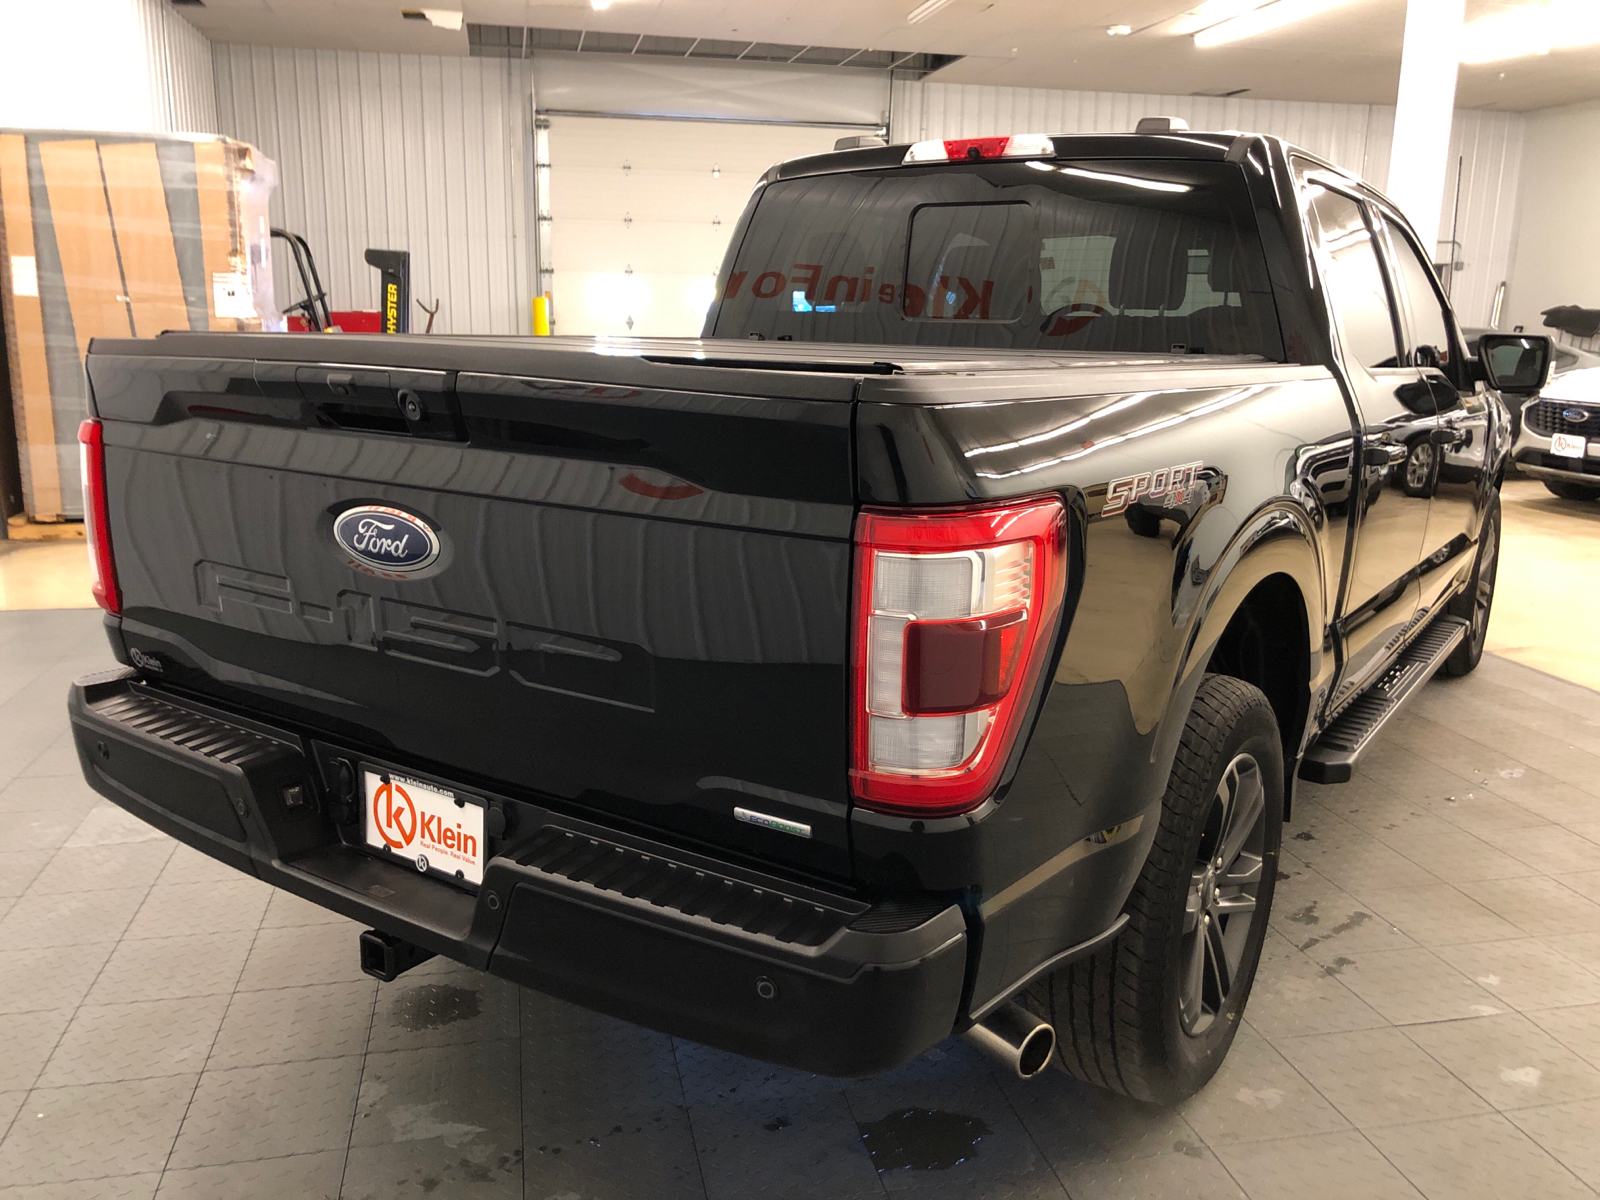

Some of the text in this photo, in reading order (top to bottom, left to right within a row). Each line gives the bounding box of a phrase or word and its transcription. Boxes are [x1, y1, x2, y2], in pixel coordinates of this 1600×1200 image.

[386, 283, 398, 334] HYSTER
[1101, 460, 1204, 518] SPORT
[353, 518, 409, 558] Ford
[388, 773, 455, 799] www.kleinauto.com
[420, 810, 477, 857] Klein
[420, 840, 477, 866] Real People. Real Value.
